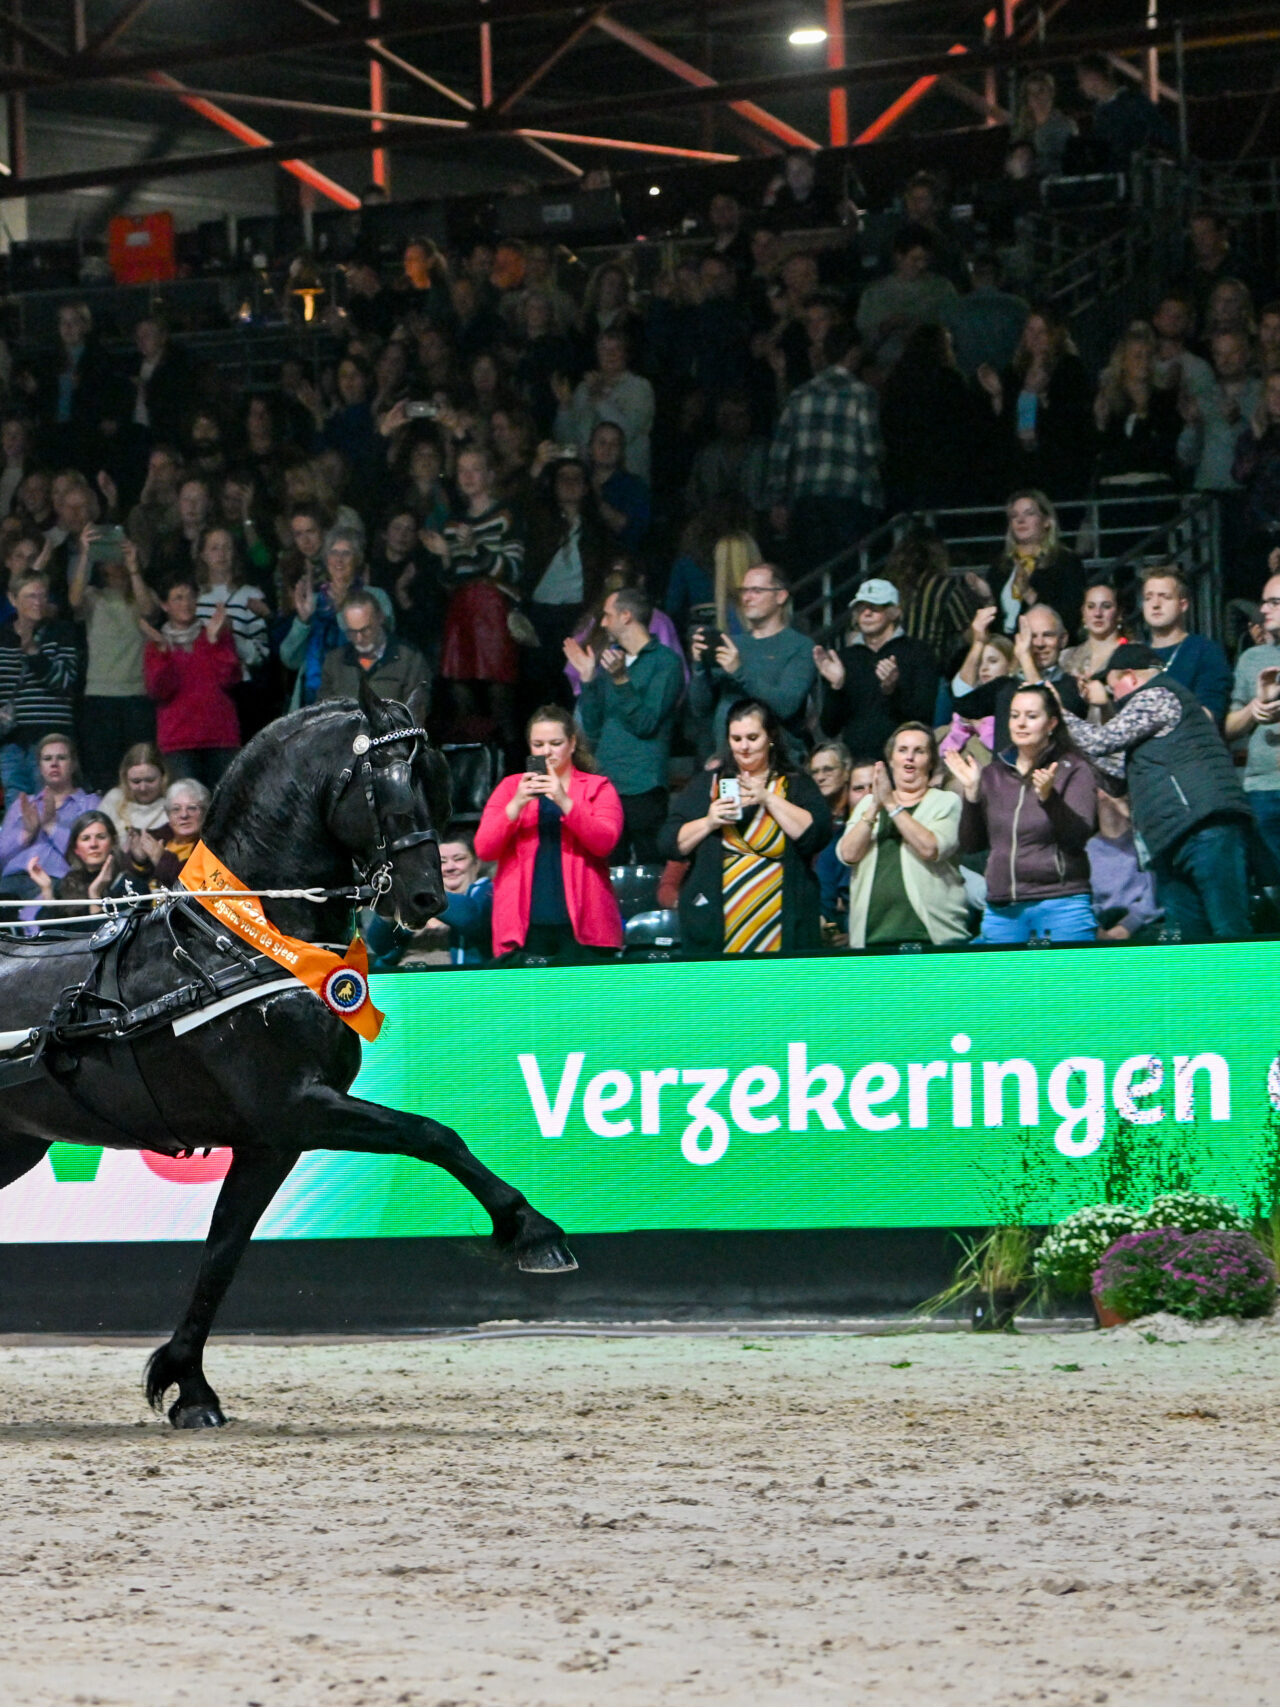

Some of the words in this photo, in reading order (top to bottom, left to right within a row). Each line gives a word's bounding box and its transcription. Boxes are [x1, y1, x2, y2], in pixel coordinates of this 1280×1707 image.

[240, 920, 259, 939] voor
[259, 933, 273, 948] de
[272, 943, 299, 964] sjees
[518, 1033, 1231, 1165] Verzekeringen
